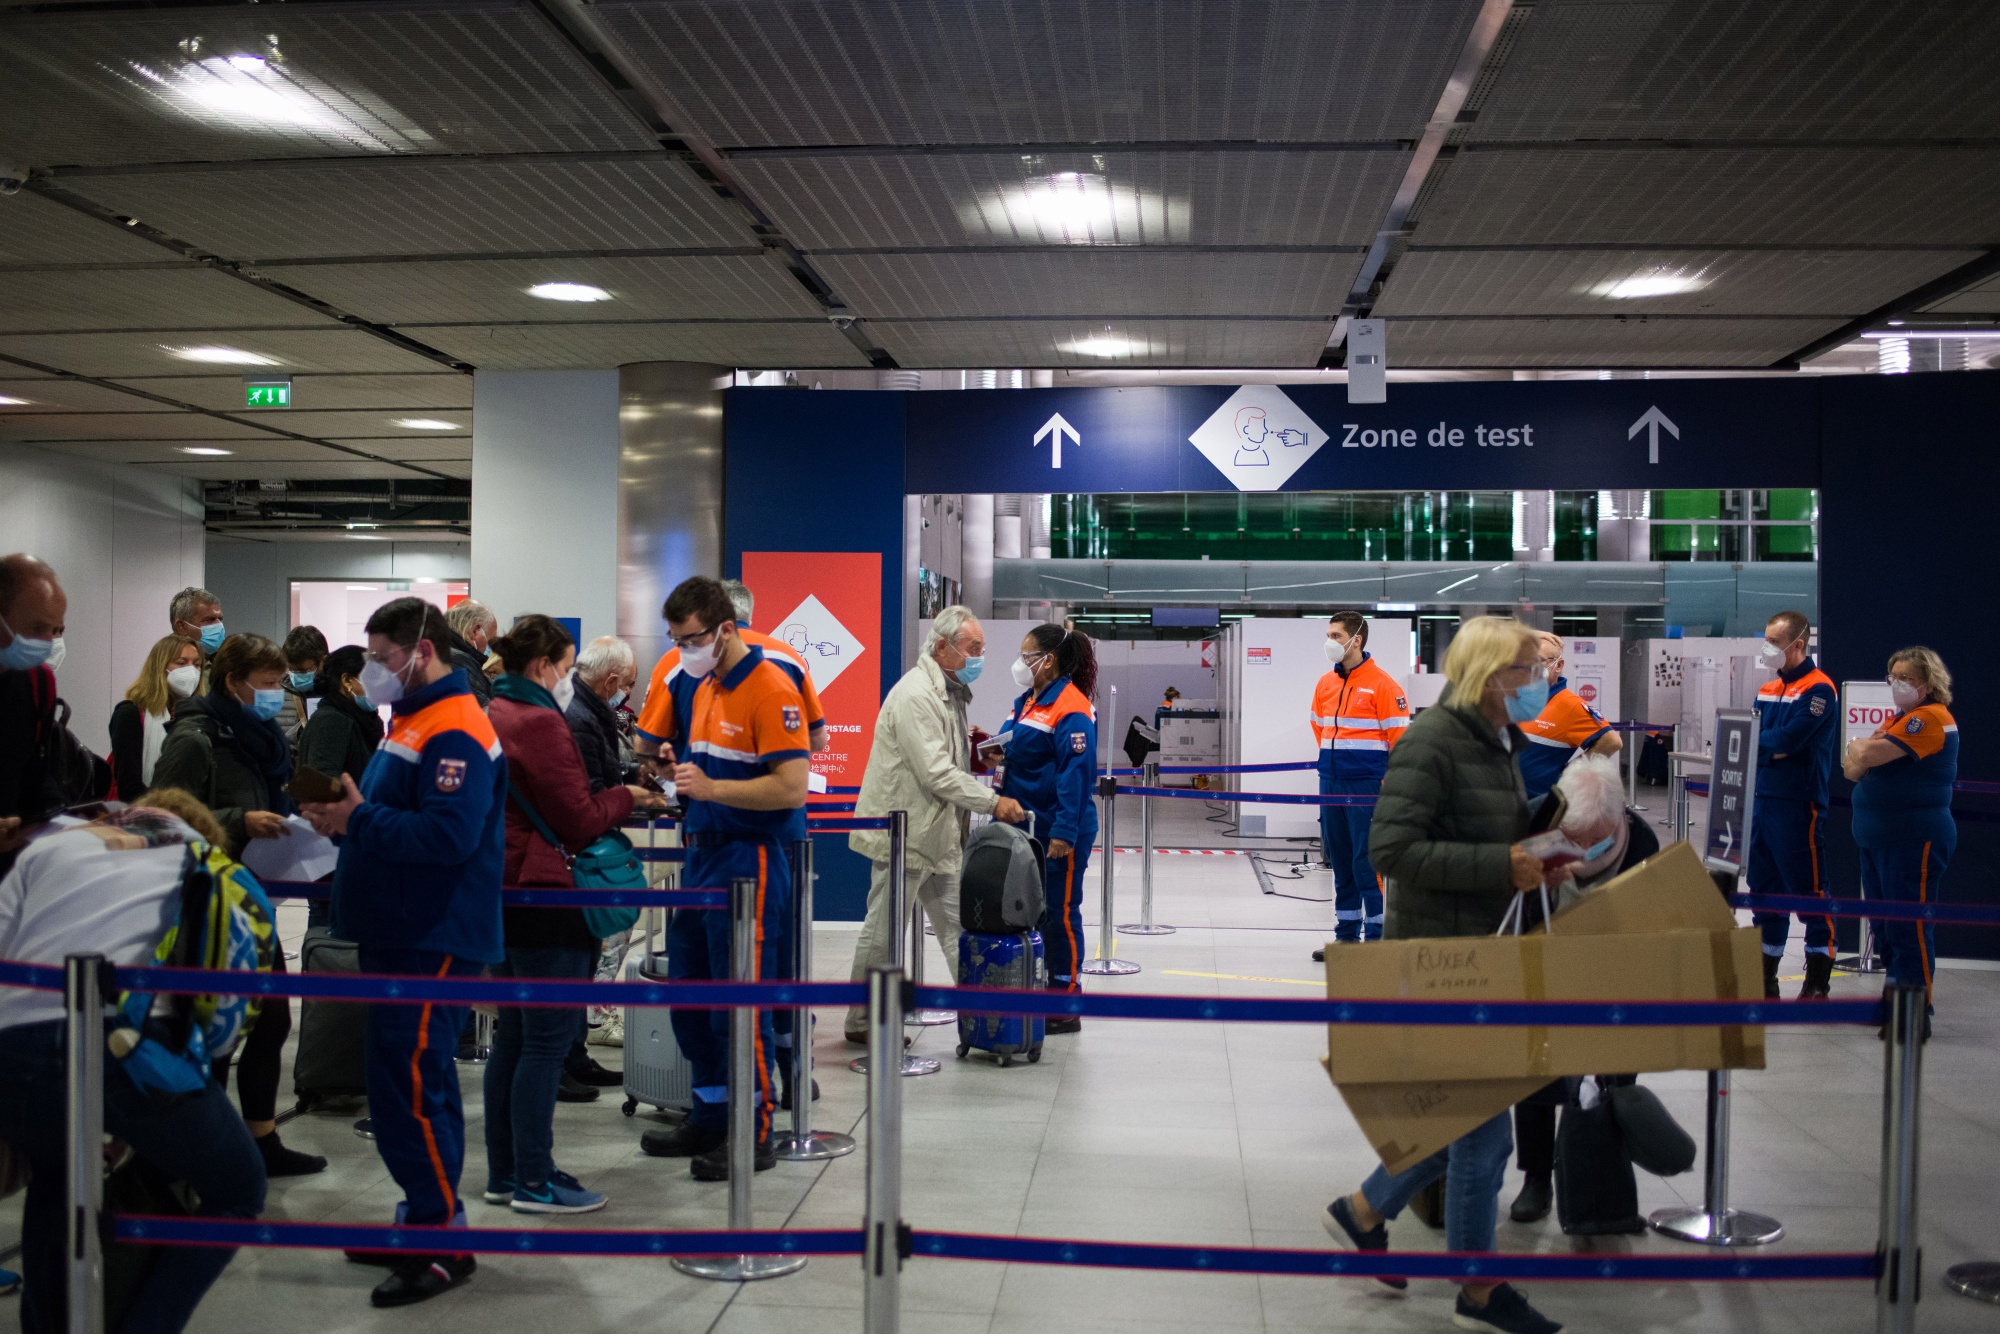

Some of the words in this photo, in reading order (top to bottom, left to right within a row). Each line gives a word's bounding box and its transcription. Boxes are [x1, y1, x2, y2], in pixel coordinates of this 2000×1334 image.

[1341, 423, 1418, 448] Zone
[1427, 421, 1465, 447] de
[1474, 423, 1534, 447] test
[1848, 707, 1895, 725] STOP
[824, 725, 862, 733] PISTAGE
[811, 753, 849, 761] CENTRE
[1720, 769, 1743, 787] SORTIE
[1722, 795, 1737, 812] EXIT
